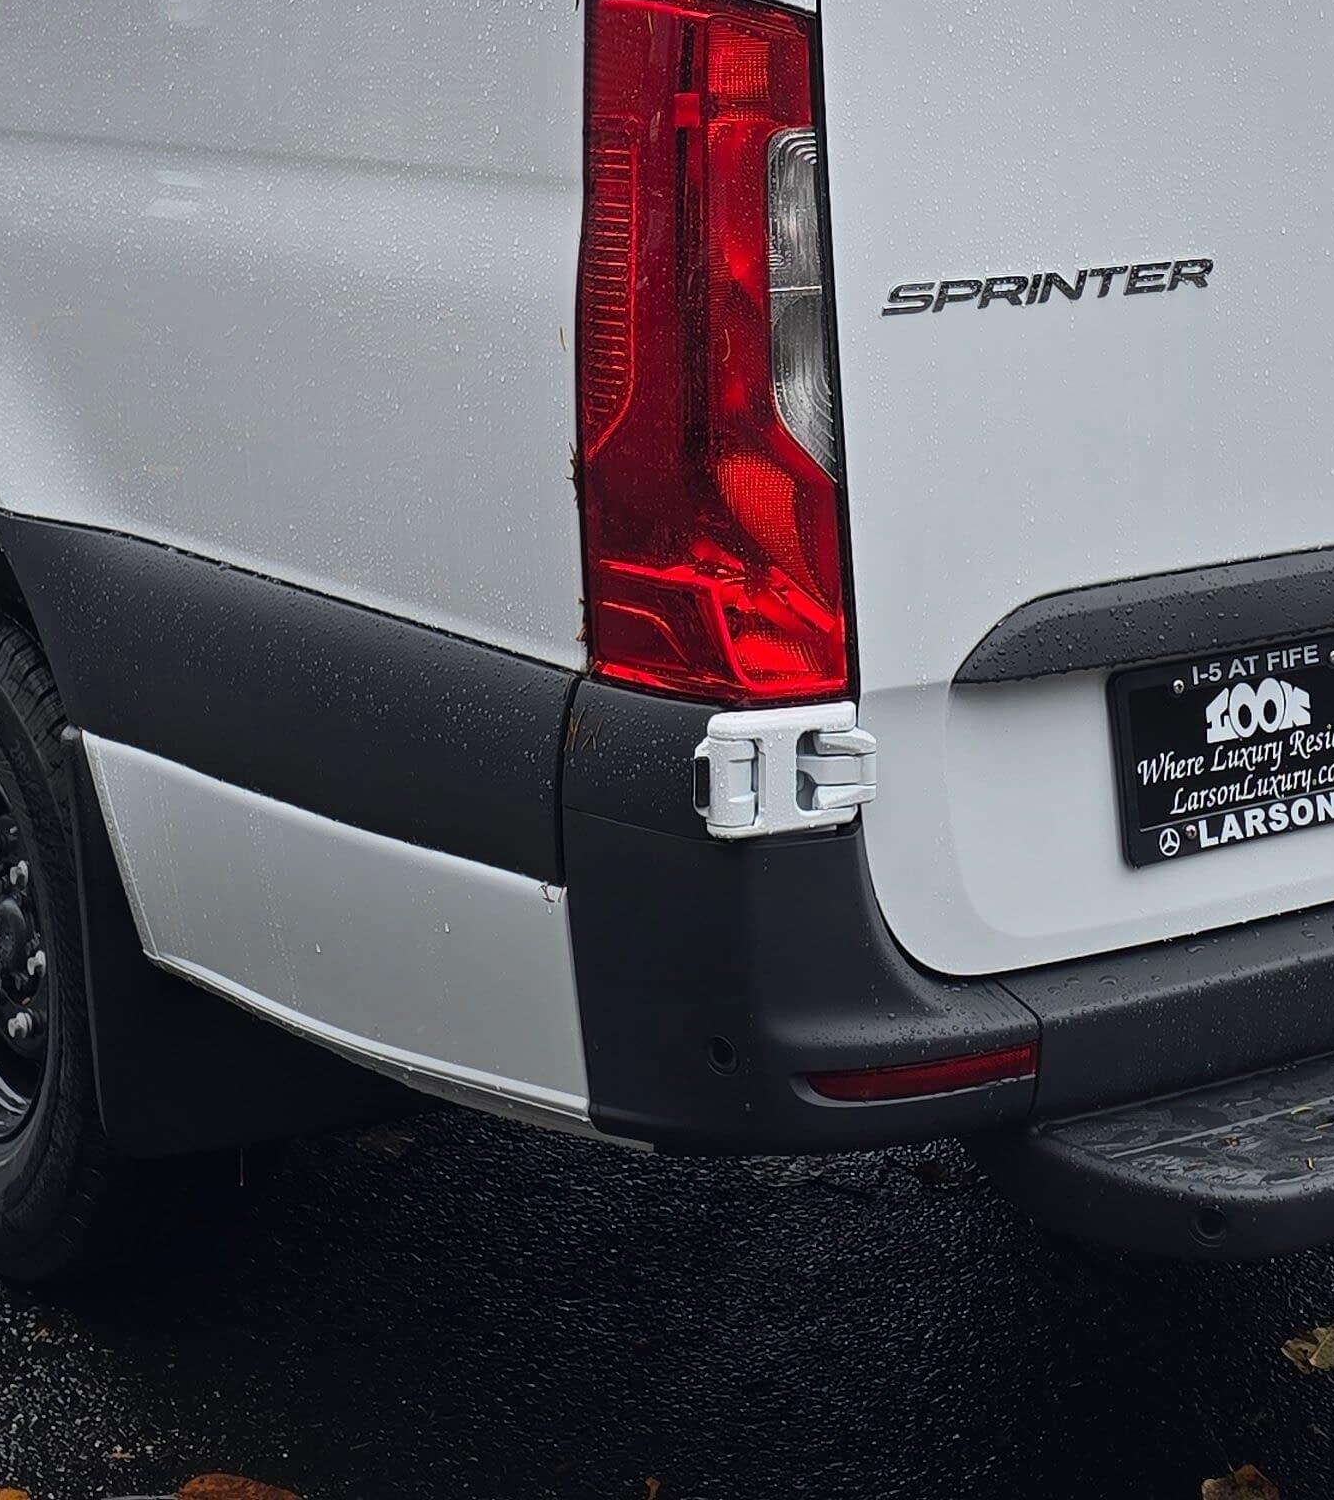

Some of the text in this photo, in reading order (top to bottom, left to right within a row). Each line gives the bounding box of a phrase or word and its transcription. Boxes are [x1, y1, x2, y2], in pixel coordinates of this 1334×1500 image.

[881, 257, 1214, 317] SPRINTER
[1192, 644, 1320, 686] I-5 AT FIFE
[1206, 677, 1311, 743] LOOK
[1137, 750, 1205, 786] Where
[1210, 740, 1284, 772] Luxury
